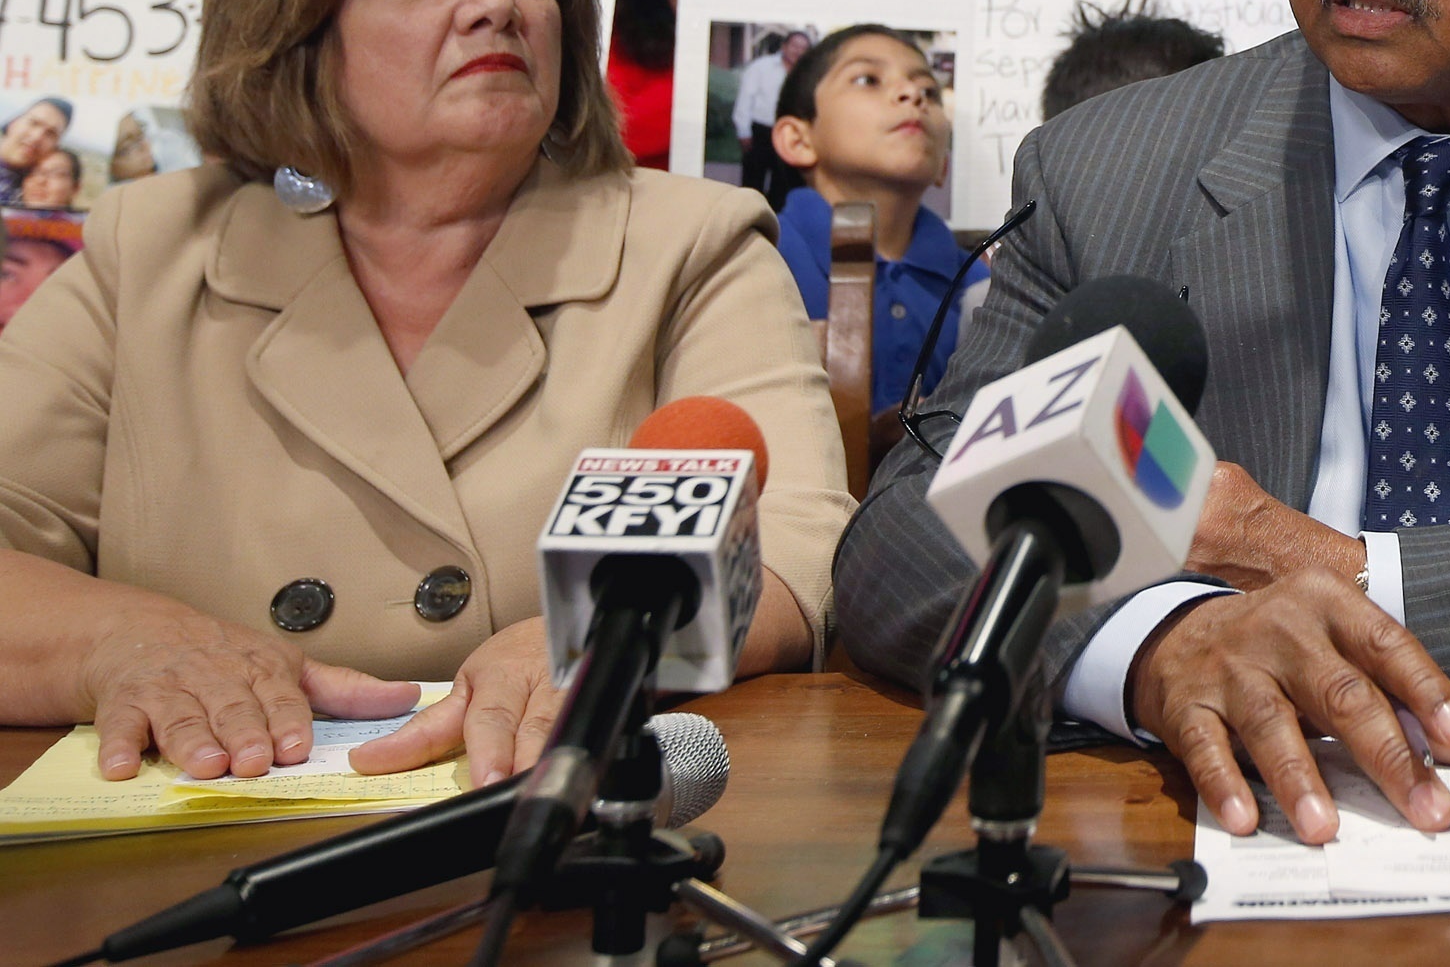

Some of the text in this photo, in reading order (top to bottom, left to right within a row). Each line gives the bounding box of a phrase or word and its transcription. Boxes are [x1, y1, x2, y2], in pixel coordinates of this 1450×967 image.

[948, 355, 1102, 466] AZ
[579, 459, 737, 471] NEWS TALK
[566, 476, 728, 505] 550
[551, 505, 721, 535] KFYI
